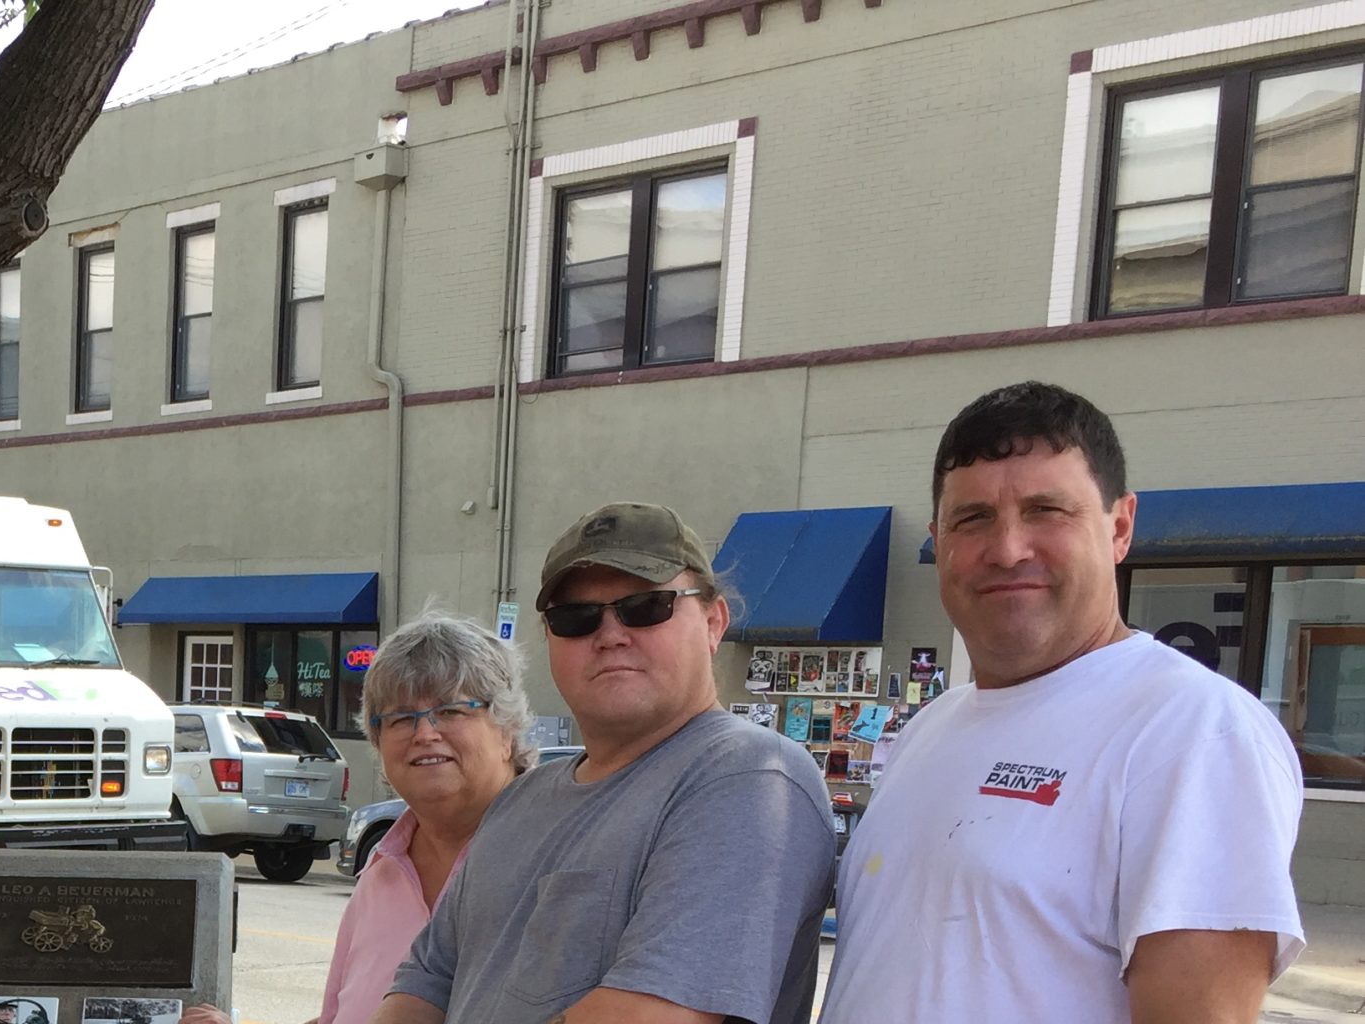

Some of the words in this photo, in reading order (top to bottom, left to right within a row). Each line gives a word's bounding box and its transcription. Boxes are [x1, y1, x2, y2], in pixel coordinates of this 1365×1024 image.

[993, 761, 1068, 781] SPECTRUM
[984, 772, 1045, 791] PAINT
[1, 884, 33, 895] LEO
[38, 885, 51, 896] A
[57, 885, 155, 897] BEUERMAN
